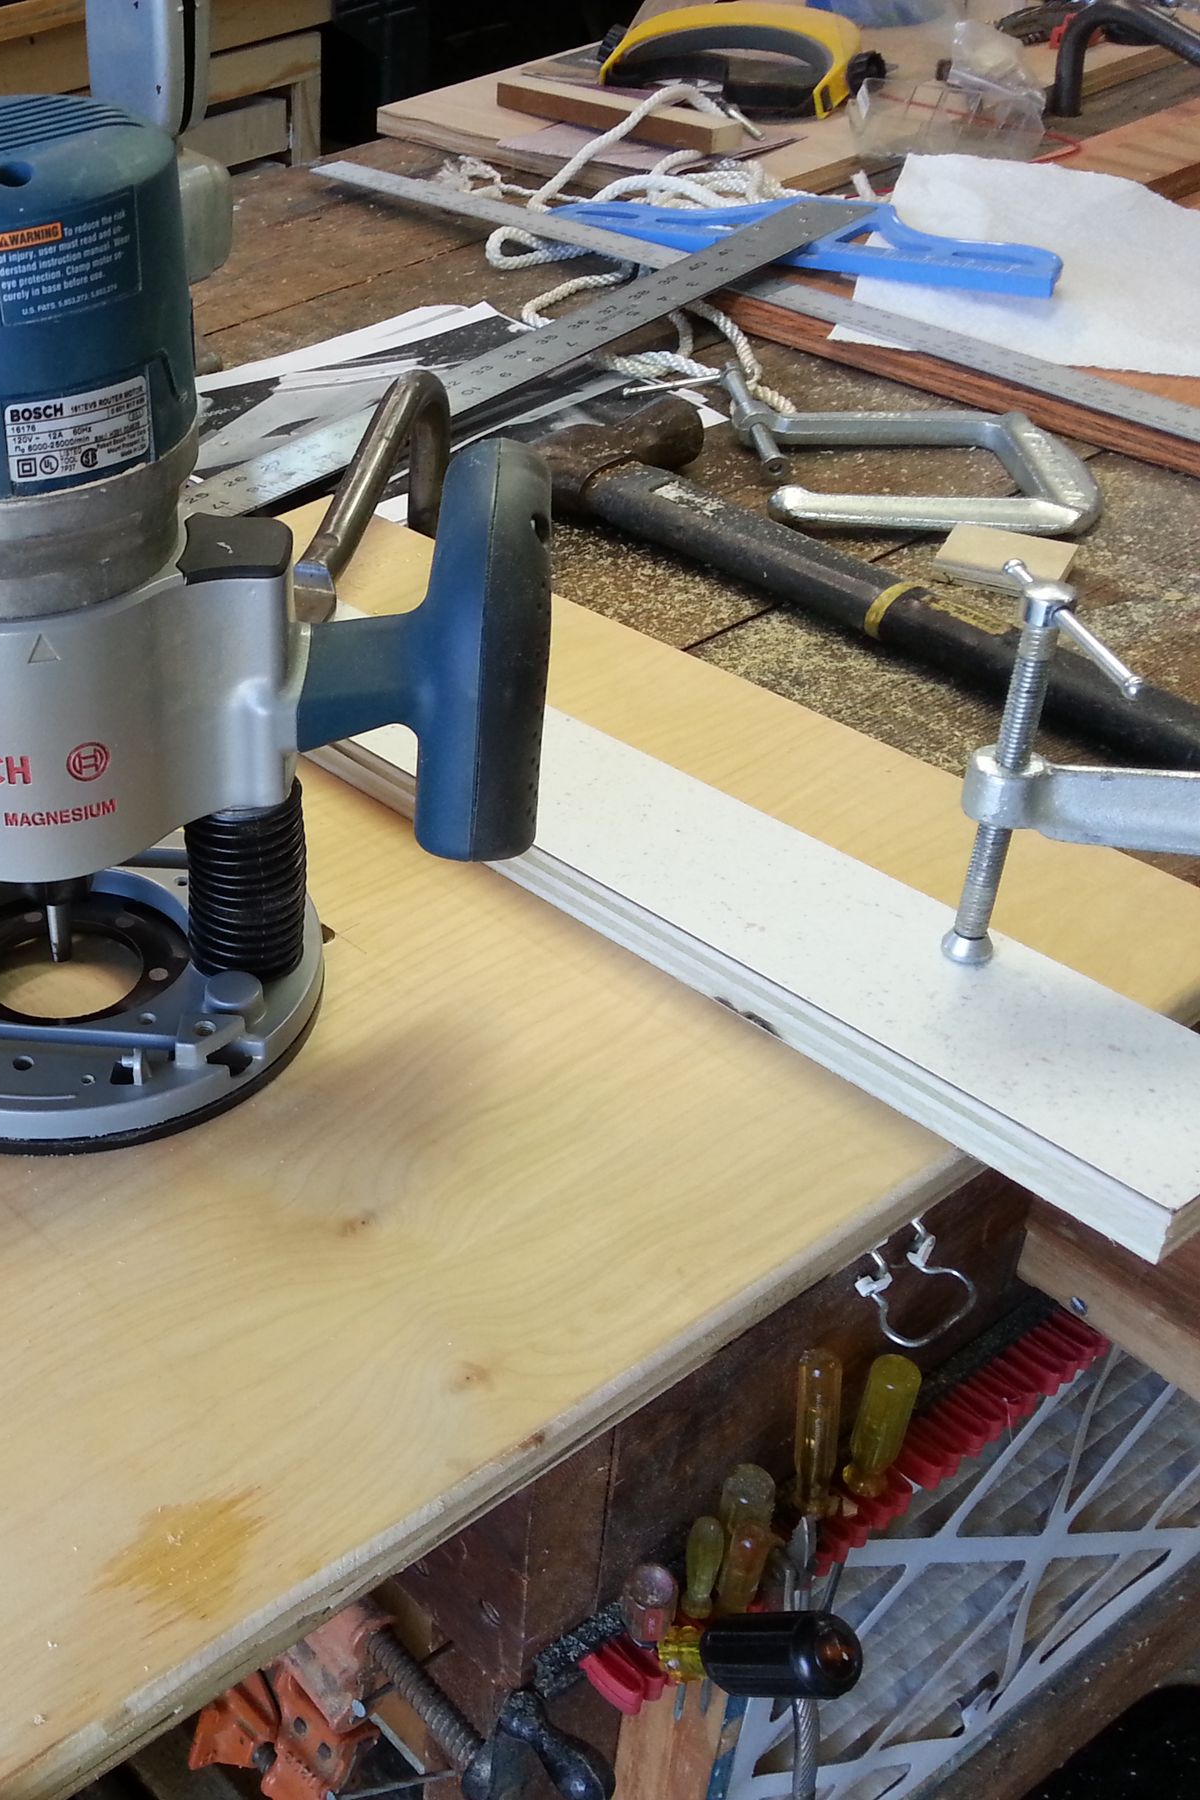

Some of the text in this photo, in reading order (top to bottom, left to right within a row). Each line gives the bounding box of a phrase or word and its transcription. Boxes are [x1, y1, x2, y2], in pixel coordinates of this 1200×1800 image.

[9, 225, 59, 246] WARNING
[64, 227, 72, 237] To
[74, 220, 100, 233] reduce
[101, 216, 112, 225] the
[38, 245, 57, 256] user
[59, 239, 78, 251] must
[80, 234, 96, 246] read
[99, 228, 111, 239] and
[0, 262, 37, 276] derstand
[40, 252, 82, 269] instruction
[1, 279, 16, 290] eye
[66, 262, 91, 276] Clamp
[92, 255, 112, 267] motor
[2, 289, 30, 302] curely
[31, 286, 40, 296] in
[42, 282, 61, 295] base
[64, 275, 88, 289] before
[10, 403, 64, 422] BOSCH
[48, 432, 63, 440] 12A
[72, 427, 92, 436] 60Hz
[4, 798, 117, 827] MAGNESIUM
